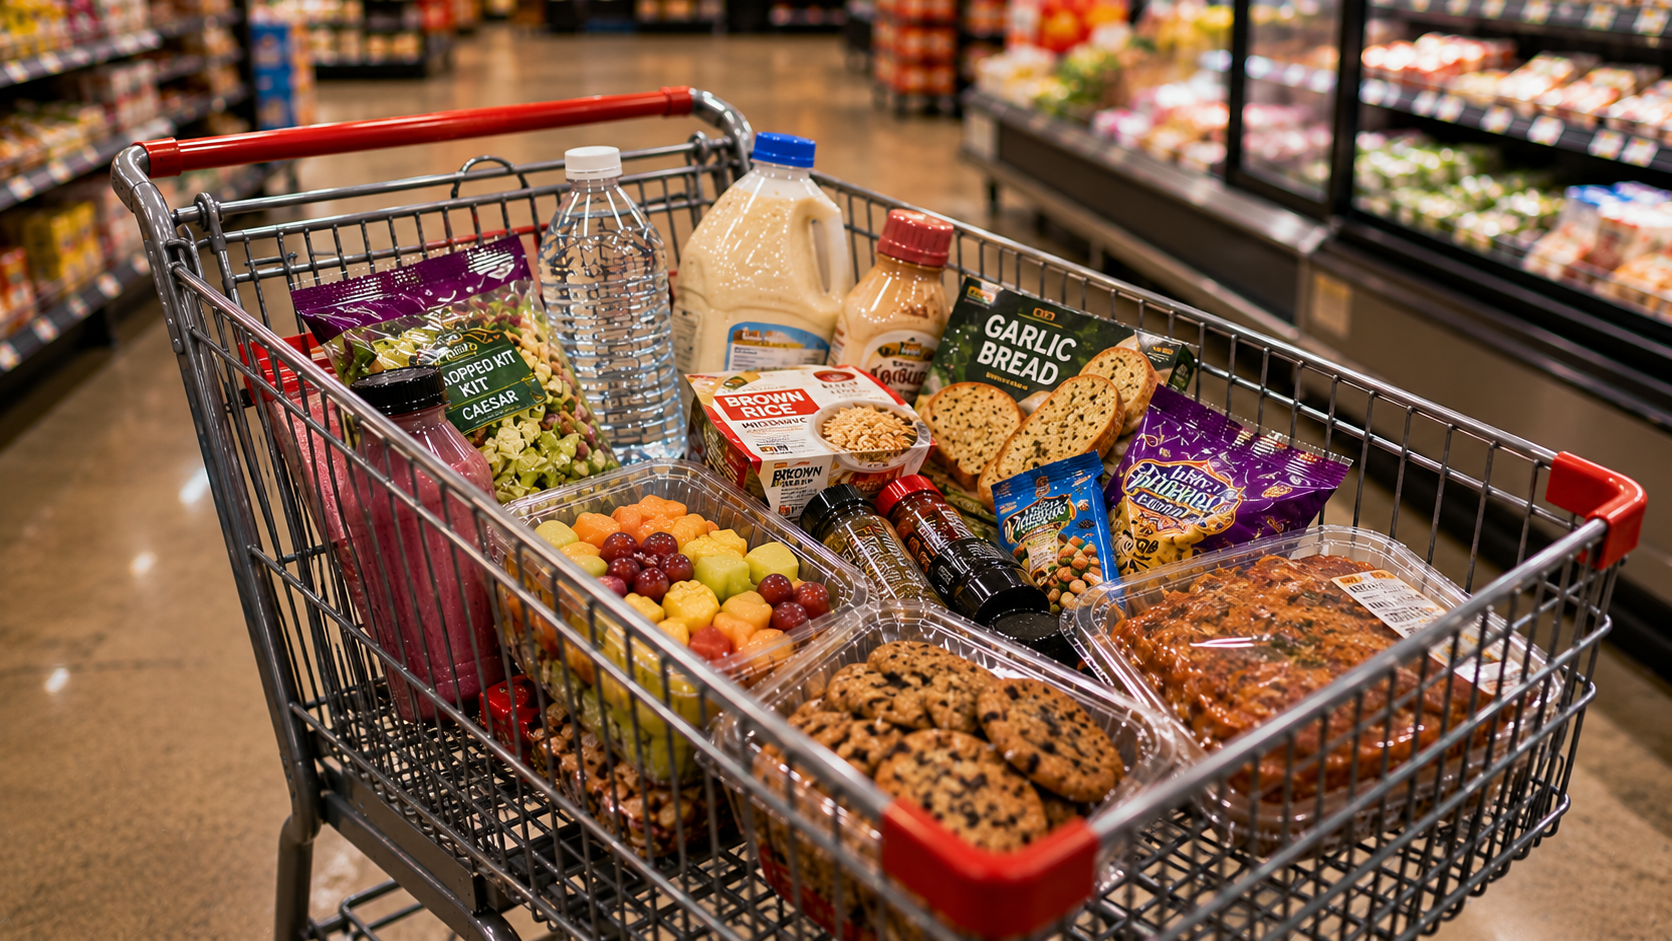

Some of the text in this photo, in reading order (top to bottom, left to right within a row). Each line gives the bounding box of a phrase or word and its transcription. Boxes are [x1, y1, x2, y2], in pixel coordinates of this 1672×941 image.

[985, 314, 1077, 362] GARLIC
[492, 350, 516, 368] KIT
[977, 340, 1059, 386] BREAD
[458, 376, 489, 398] KIT
[462, 390, 520, 420] CAESAR
[723, 390, 805, 407] BROWN
[740, 403, 798, 418] RICE
